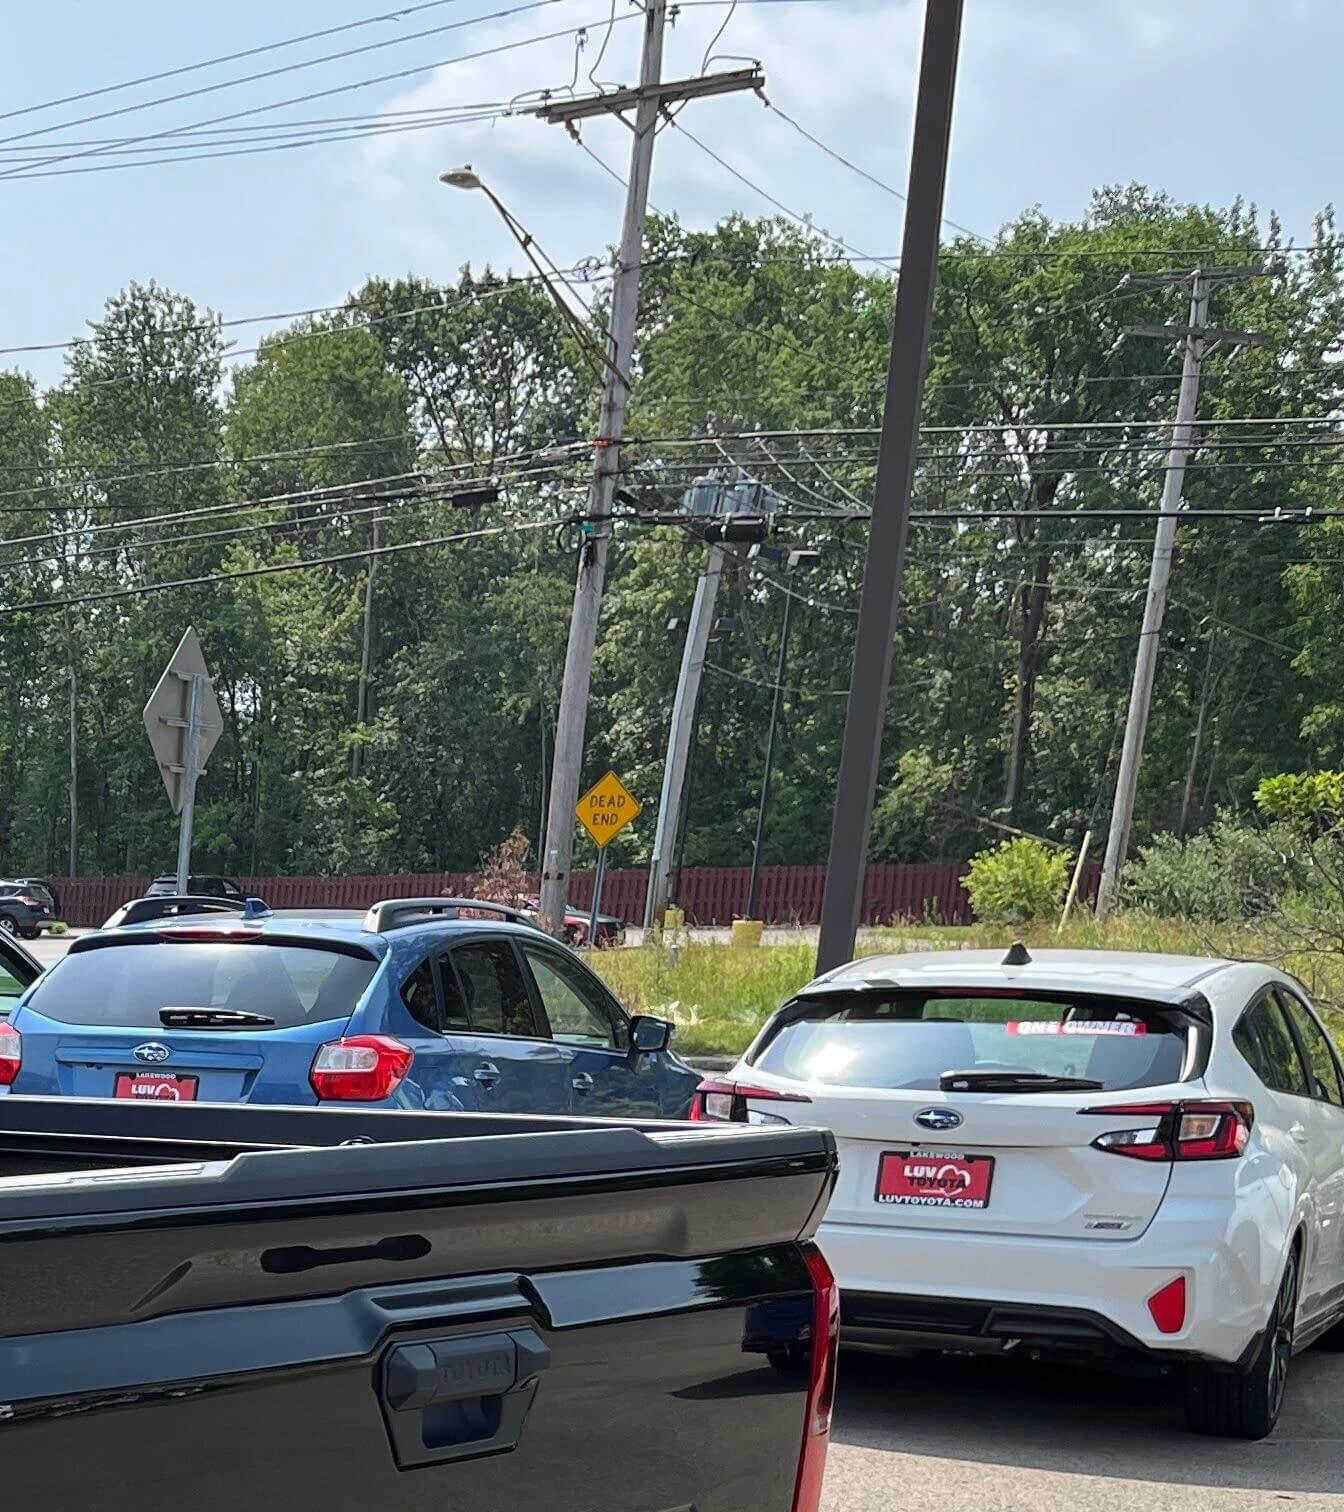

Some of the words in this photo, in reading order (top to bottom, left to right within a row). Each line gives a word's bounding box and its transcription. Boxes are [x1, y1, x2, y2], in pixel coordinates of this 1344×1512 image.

[590, 795, 626, 808] DEAD
[592, 813, 619, 826] END
[1017, 1021, 1059, 1035] ONE
[1062, 1021, 1137, 1036] OWNER
[131, 1084, 156, 1095] LUV
[909, 1150, 965, 1160] LAKEWOOD
[903, 1165, 937, 1178] LUV
[908, 1177, 966, 1189] TOYOTA
[878, 1194, 984, 1208] LUVTOYOTA.COM
